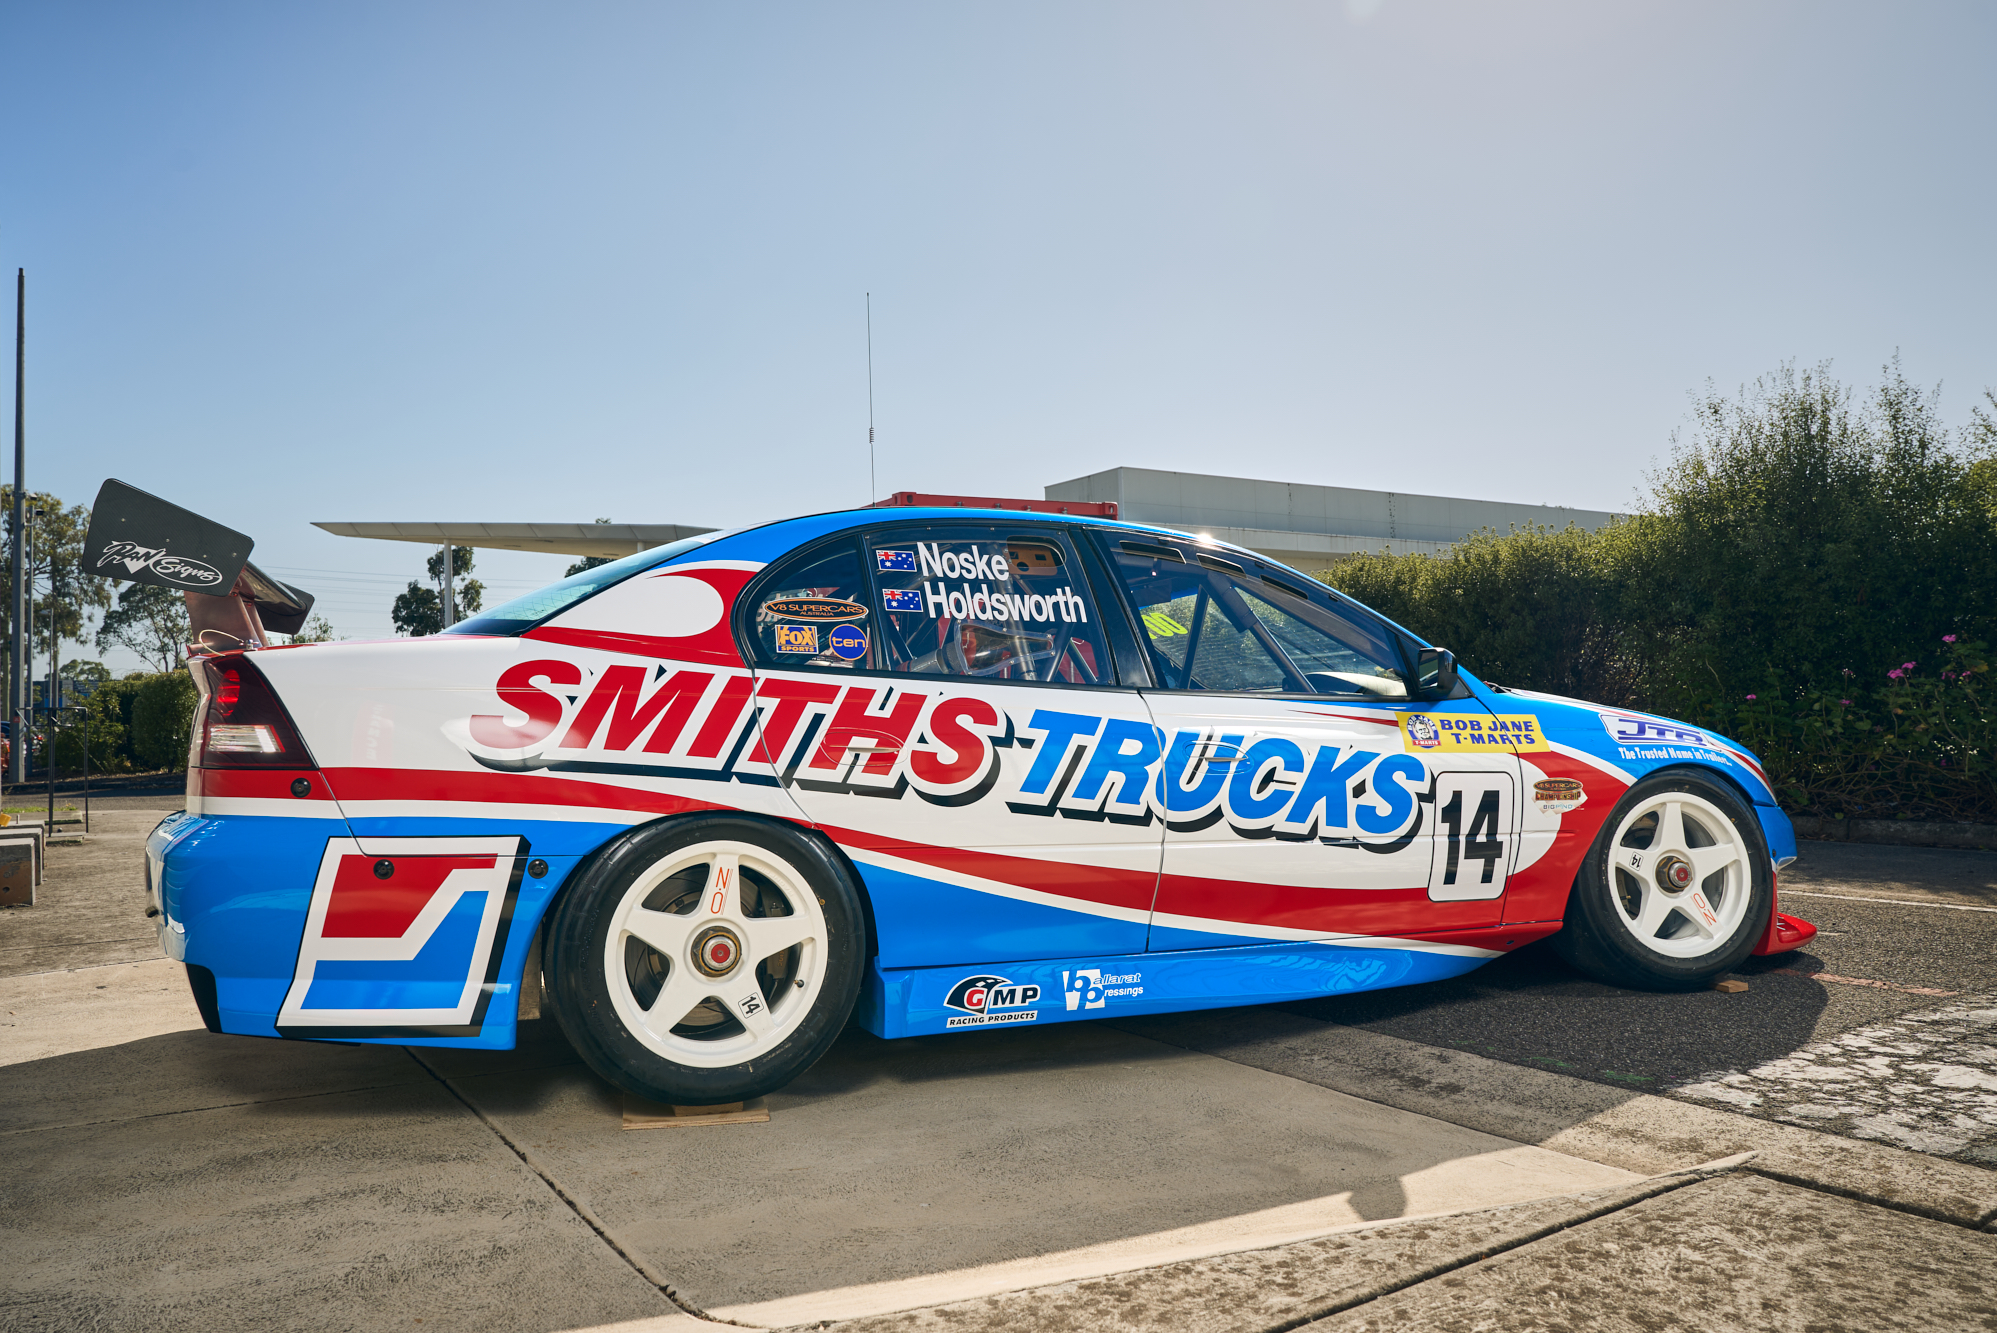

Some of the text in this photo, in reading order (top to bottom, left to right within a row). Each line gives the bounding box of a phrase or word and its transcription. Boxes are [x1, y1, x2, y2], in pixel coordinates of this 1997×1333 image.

[917, 542, 1010, 580] Noske
[156, 559, 219, 581] Signs
[770, 603, 863, 613] V8 SUPERCARS
[924, 582, 1087, 623] Holdsworth
[779, 629, 814, 646] FOX
[832, 637, 866, 648] ten
[467, 658, 1004, 790] SMITHS
[1439, 719, 1535, 732] BOB JANE
[1451, 733, 1536, 745] T-MARTS
[1618, 747, 1636, 759] The
[1634, 747, 1666, 759] Trusted
[1667, 747, 1694, 759] Name
[1691, 748, 1703, 759] in
[1018, 708, 1426, 836] TRUCKS
[1441, 790, 1503, 884] 14
[1631, 854, 1642, 868] 14
[741, 996, 760, 1014] 14
[965, 986, 1039, 1007] GMP
[949, 1012, 1035, 1026] RACING PRODUCTS
